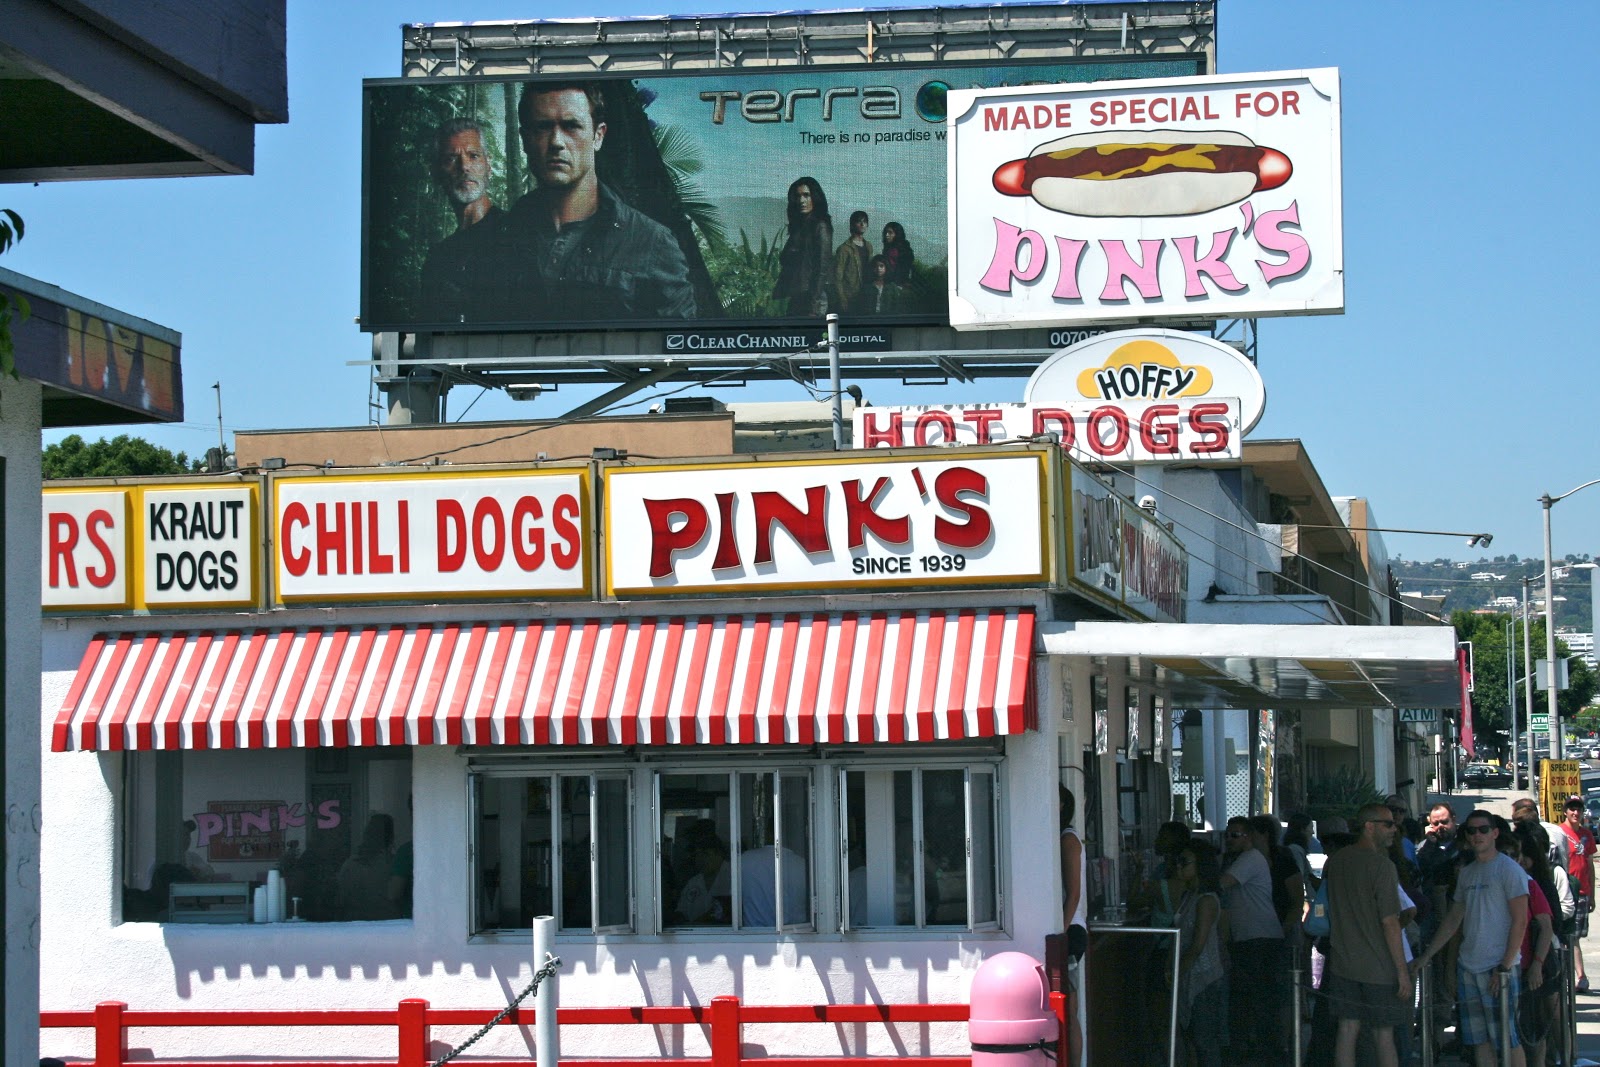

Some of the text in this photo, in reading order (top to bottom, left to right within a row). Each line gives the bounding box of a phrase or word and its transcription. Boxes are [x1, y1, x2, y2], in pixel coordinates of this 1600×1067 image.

[700, 86, 902, 124] Terra
[984, 90, 1300, 131] MADE SPECIAL FOR
[800, 131, 836, 144] There
[840, 131, 849, 143] is
[854, 132, 871, 142] no
[875, 129, 931, 145] paradise
[979, 199, 1311, 300] PINK'S
[839, 335, 885, 343] DIGITAL
[1098, 364, 1194, 401] HOFFY
[863, 402, 1230, 455] HOT DOGS
[150, 500, 244, 541] KRAUT
[281, 494, 581, 577] CHILI DOGS
[642, 467, 993, 579] PINK'S
[156, 550, 238, 591] DOGS
[852, 554, 966, 574] SINCE 1939
[1401, 708, 1434, 720] ATM
[1532, 716, 1548, 724] ATM
[1550, 763, 1577, 772] SPECIAL
[1551, 776, 1578, 786] $75.00
[193, 799, 342, 848] PINK'S
